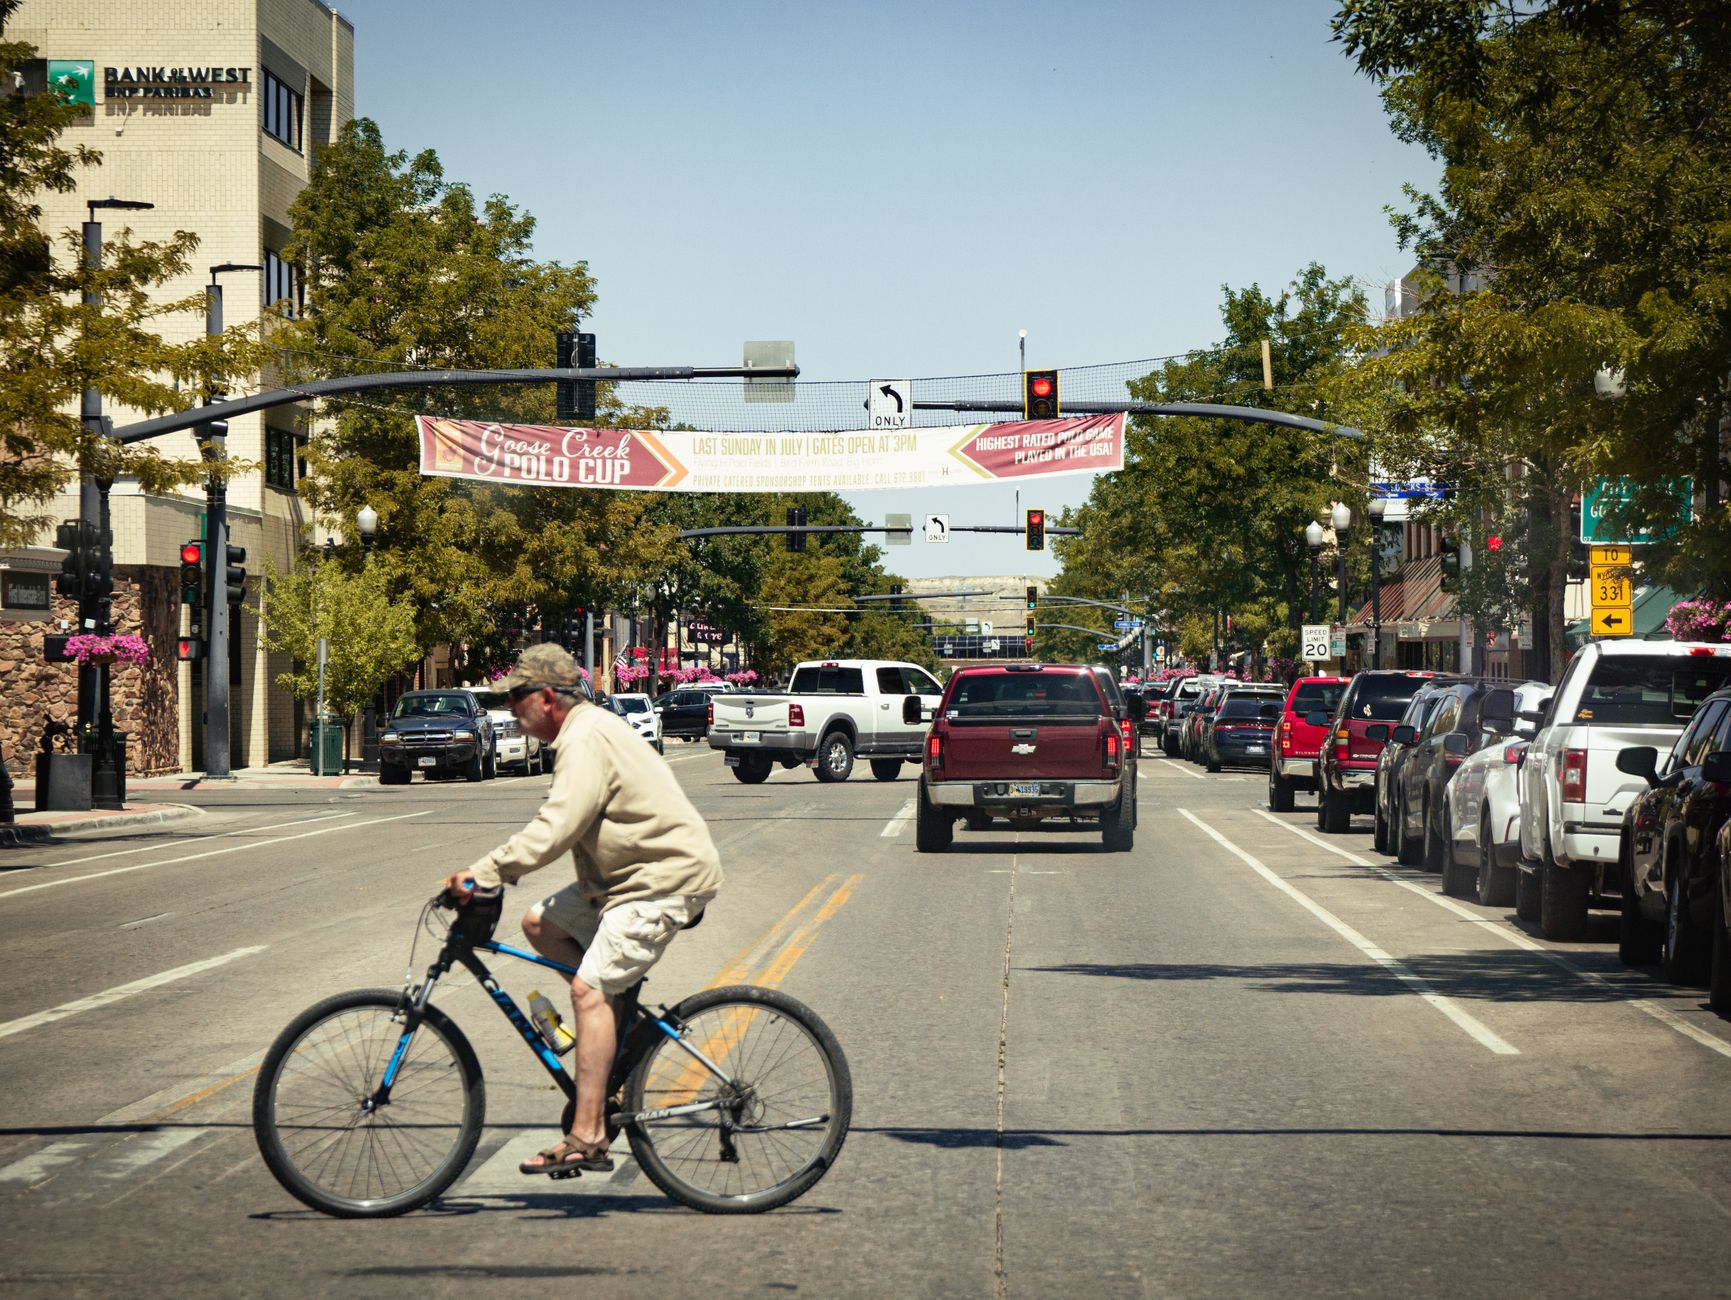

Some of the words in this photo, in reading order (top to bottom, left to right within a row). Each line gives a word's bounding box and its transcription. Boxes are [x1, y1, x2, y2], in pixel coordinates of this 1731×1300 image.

[104, 67, 165, 83] BANK
[170, 68, 184, 76] OF
[188, 67, 252, 83] WEST
[105, 87, 139, 98] BNP
[143, 87, 212, 98] PARIBAS
[875, 416, 906, 426] ONLY
[693, 437, 718, 455] LAST
[721, 437, 762, 455] SUNDAY
[766, 438, 776, 455] IN
[780, 438, 802, 455] JULY
[813, 437, 844, 455] GATES
[848, 436, 875, 454] OPEN
[879, 435, 890, 453] AT
[893, 434, 917, 452] 3PM
[976, 435, 1020, 451] HIGHEST
[1022, 432, 1055, 447] RATED
[1086, 425, 1114, 440] GAME
[474, 424, 551, 476] Goose
[561, 429, 631, 459] Creek
[1014, 449, 1053, 464] PLAYED
[1055, 447, 1065, 460] IN
[1068, 444, 1087, 458] THE
[1089, 442, 1113, 456] USA!
[503, 452, 570, 481] POLO
[578, 458, 631, 484] CUP
[1603, 549, 1618, 561] TO
[1600, 586, 1623, 600] 331
[1305, 643, 1327, 656] 20
